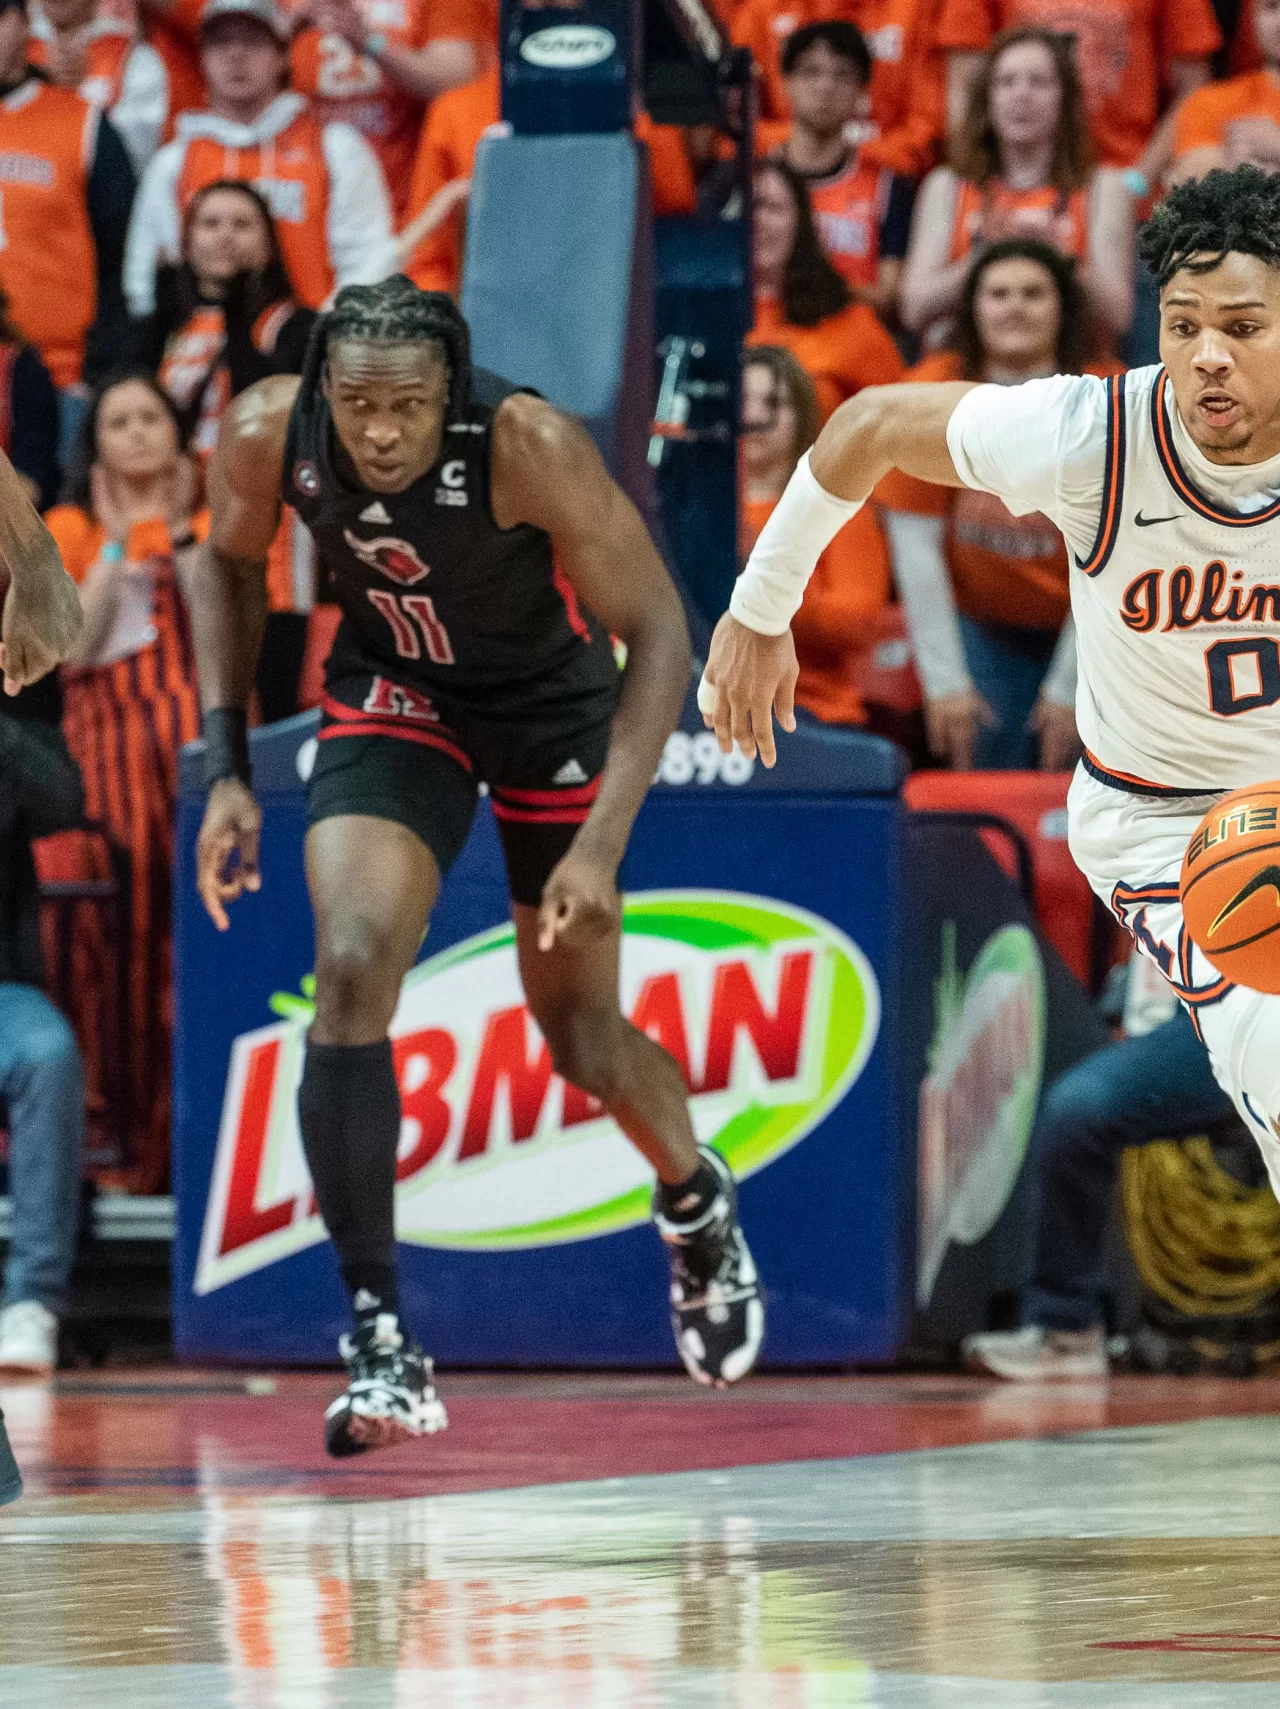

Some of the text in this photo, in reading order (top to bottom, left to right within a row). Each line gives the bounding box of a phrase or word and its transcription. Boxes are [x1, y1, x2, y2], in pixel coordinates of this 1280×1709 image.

[441, 459, 466, 488] C
[366, 588, 455, 665] 11
[1187, 806, 1279, 868] ELITE
[219, 948, 816, 1258] LBMAN
